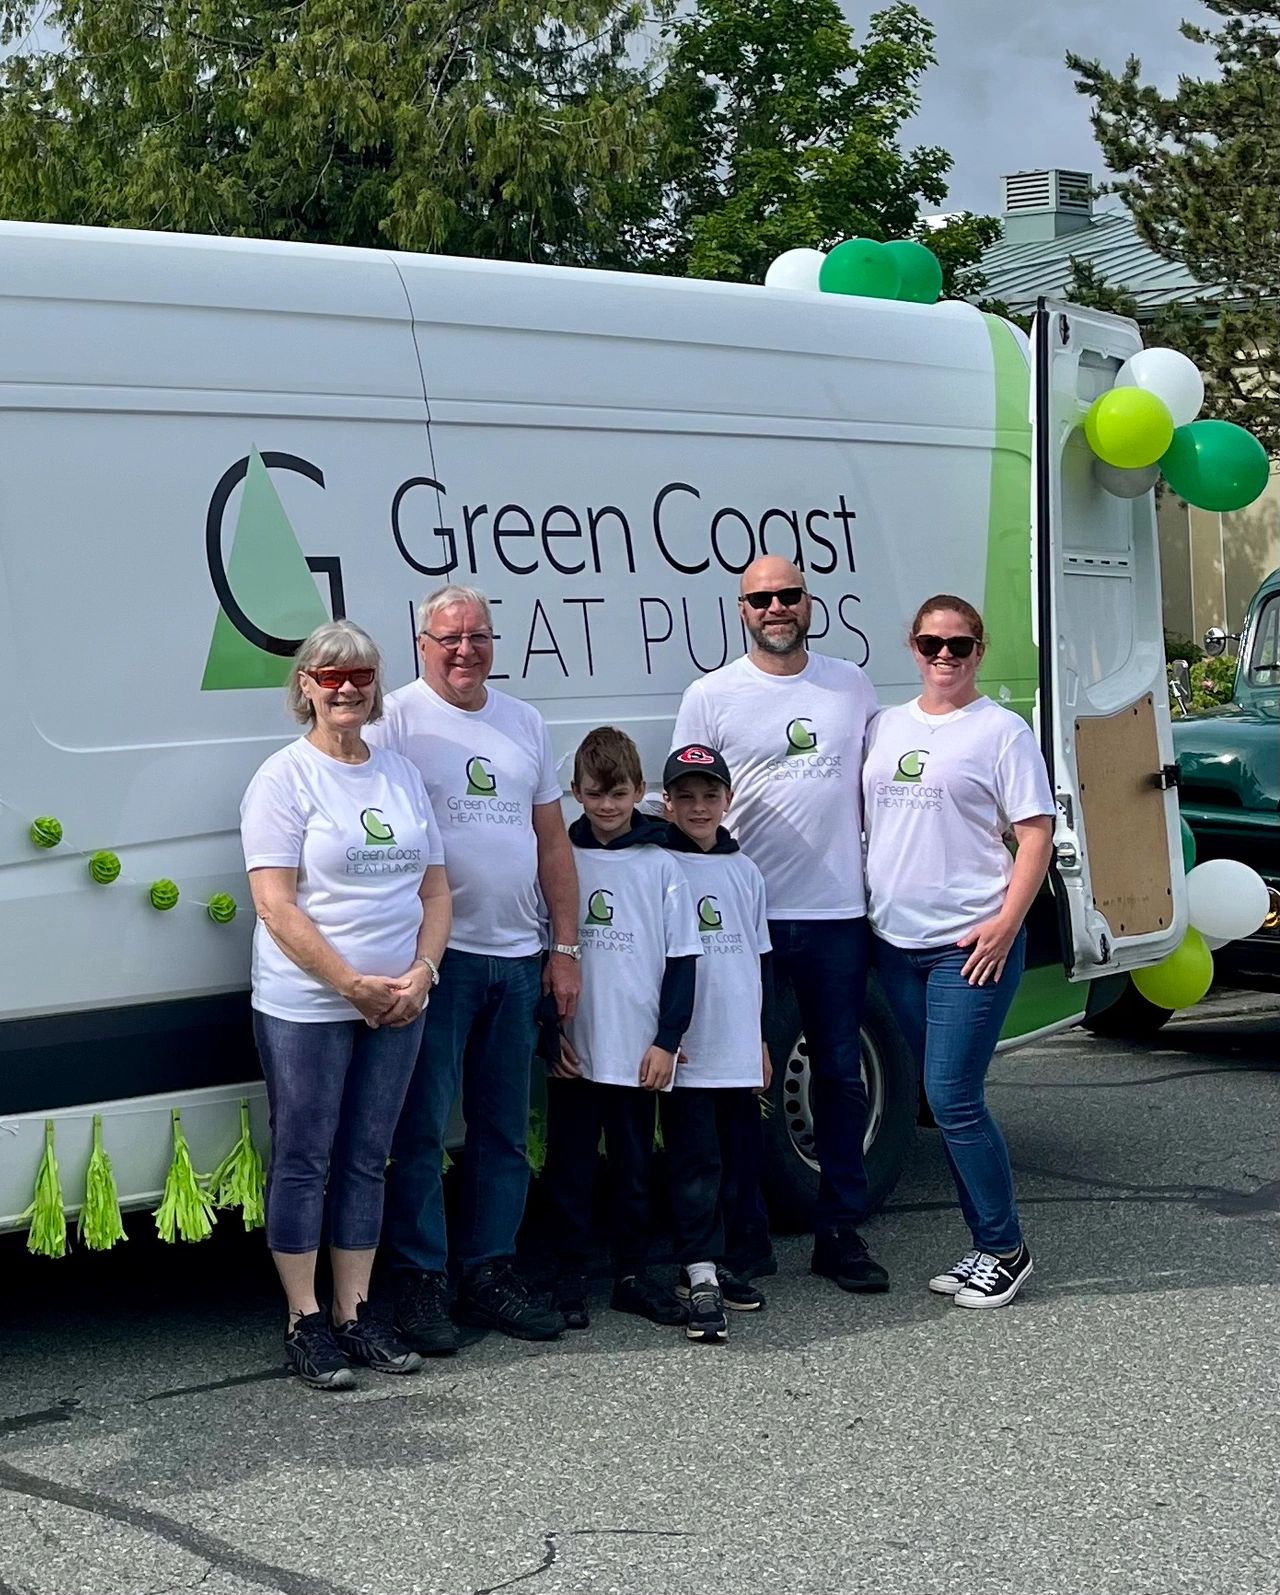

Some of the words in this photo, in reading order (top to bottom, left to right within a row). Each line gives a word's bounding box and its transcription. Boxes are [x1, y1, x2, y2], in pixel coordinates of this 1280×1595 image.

[391, 476, 636, 577] Green
[652, 481, 857, 575] Coast
[766, 758, 805, 771] Green
[807, 755, 842, 767] Coast
[803, 768, 842, 779] PUMPS
[876, 781, 910, 796] Green
[911, 784, 944, 799] Coast
[447, 796, 487, 811] Green
[488, 797, 522, 814] Coast
[877, 797, 905, 808] HEAT
[905, 798, 943, 812] PUMPS
[450, 812, 485, 824] HEAT
[486, 813, 523, 826] PUMPS
[345, 846, 385, 861] Green
[387, 846, 421, 861] Coast
[346, 863, 380, 875] HEAT
[381, 862, 420, 874] PUMPS
[577, 927, 600, 938] reen
[601, 926, 635, 944] Coast
[596, 939, 634, 954] PUMPS
